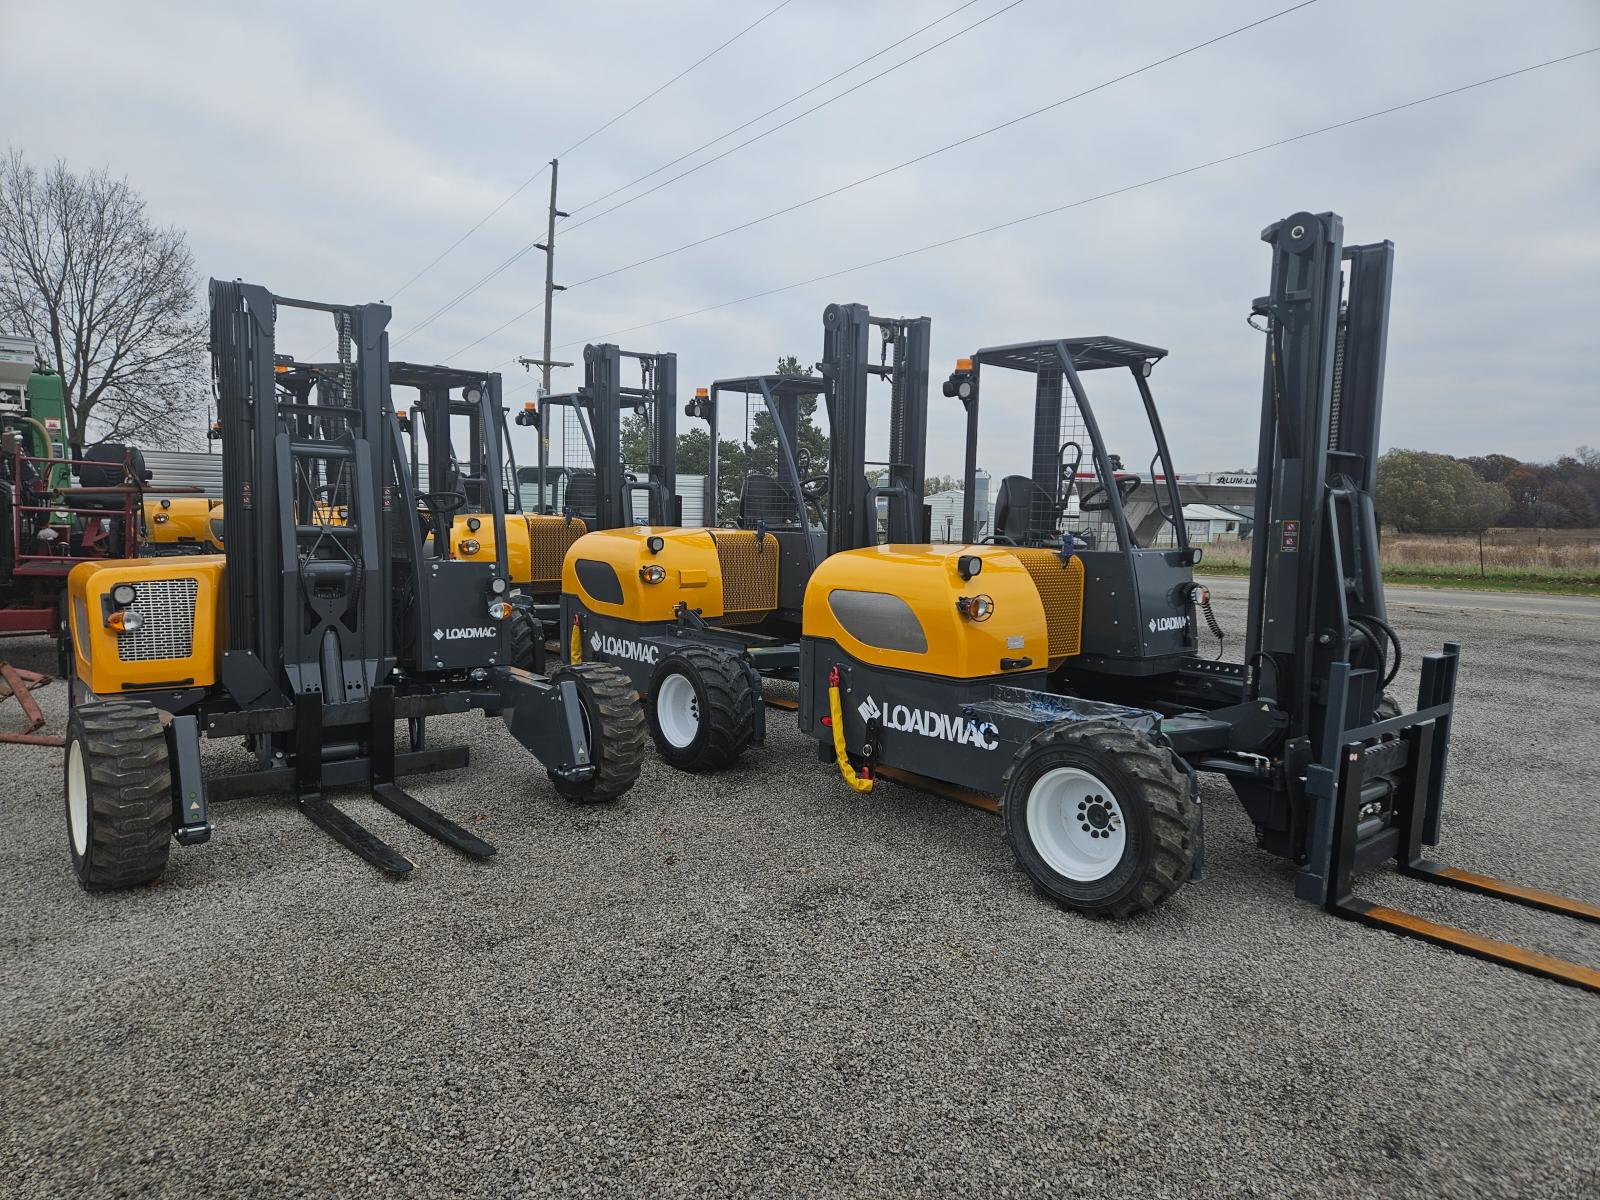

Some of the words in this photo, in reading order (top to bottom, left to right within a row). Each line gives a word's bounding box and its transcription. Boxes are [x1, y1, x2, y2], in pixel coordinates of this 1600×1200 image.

[1217, 475, 1258, 485] ALUM-LIN
[446, 626, 497, 640] LOADMAC
[602, 634, 659, 665] LOADMAC
[882, 702, 999, 751] LOADMAC
